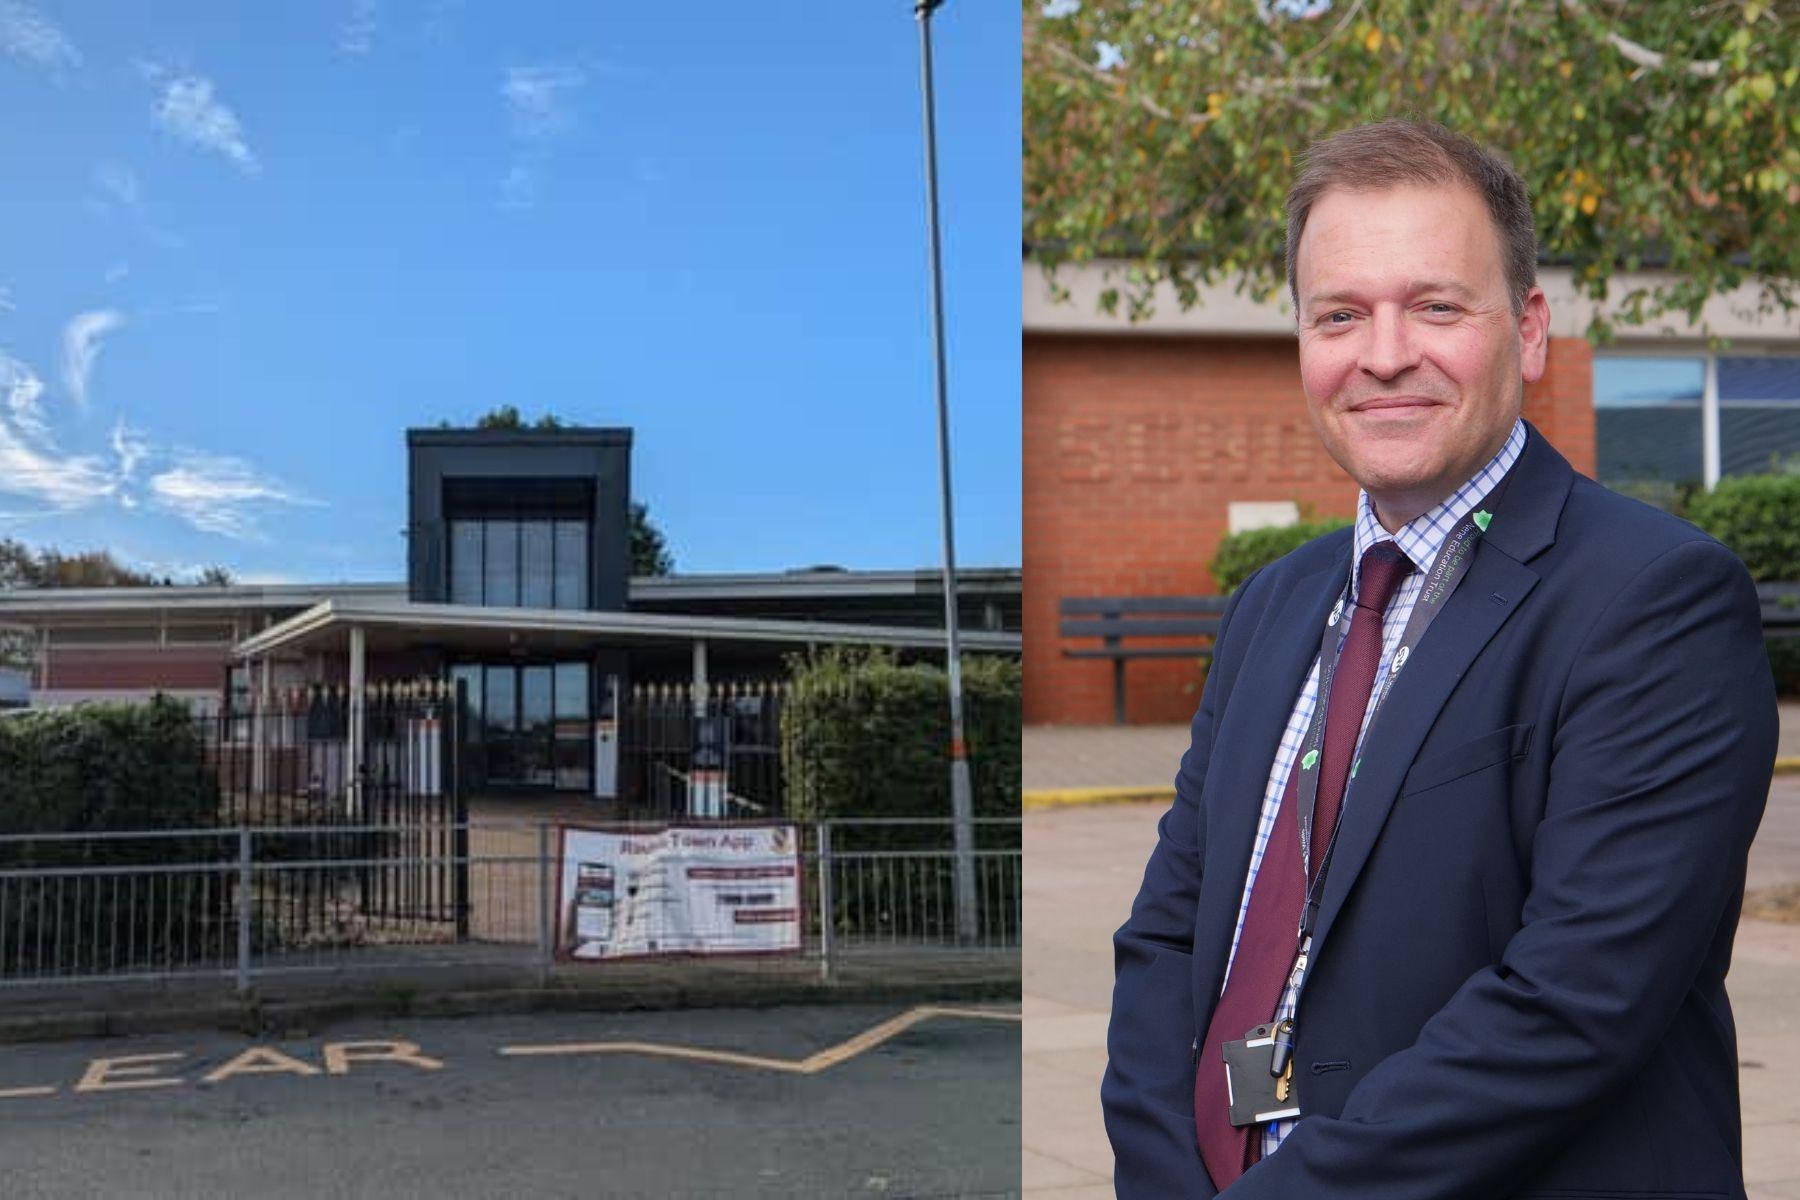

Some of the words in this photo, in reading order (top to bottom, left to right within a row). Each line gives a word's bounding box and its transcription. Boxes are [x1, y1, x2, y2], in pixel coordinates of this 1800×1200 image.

[1456, 522, 1475, 540] Nene
[1434, 539, 1460, 581] Education
[1423, 580, 1438, 602] Trust
